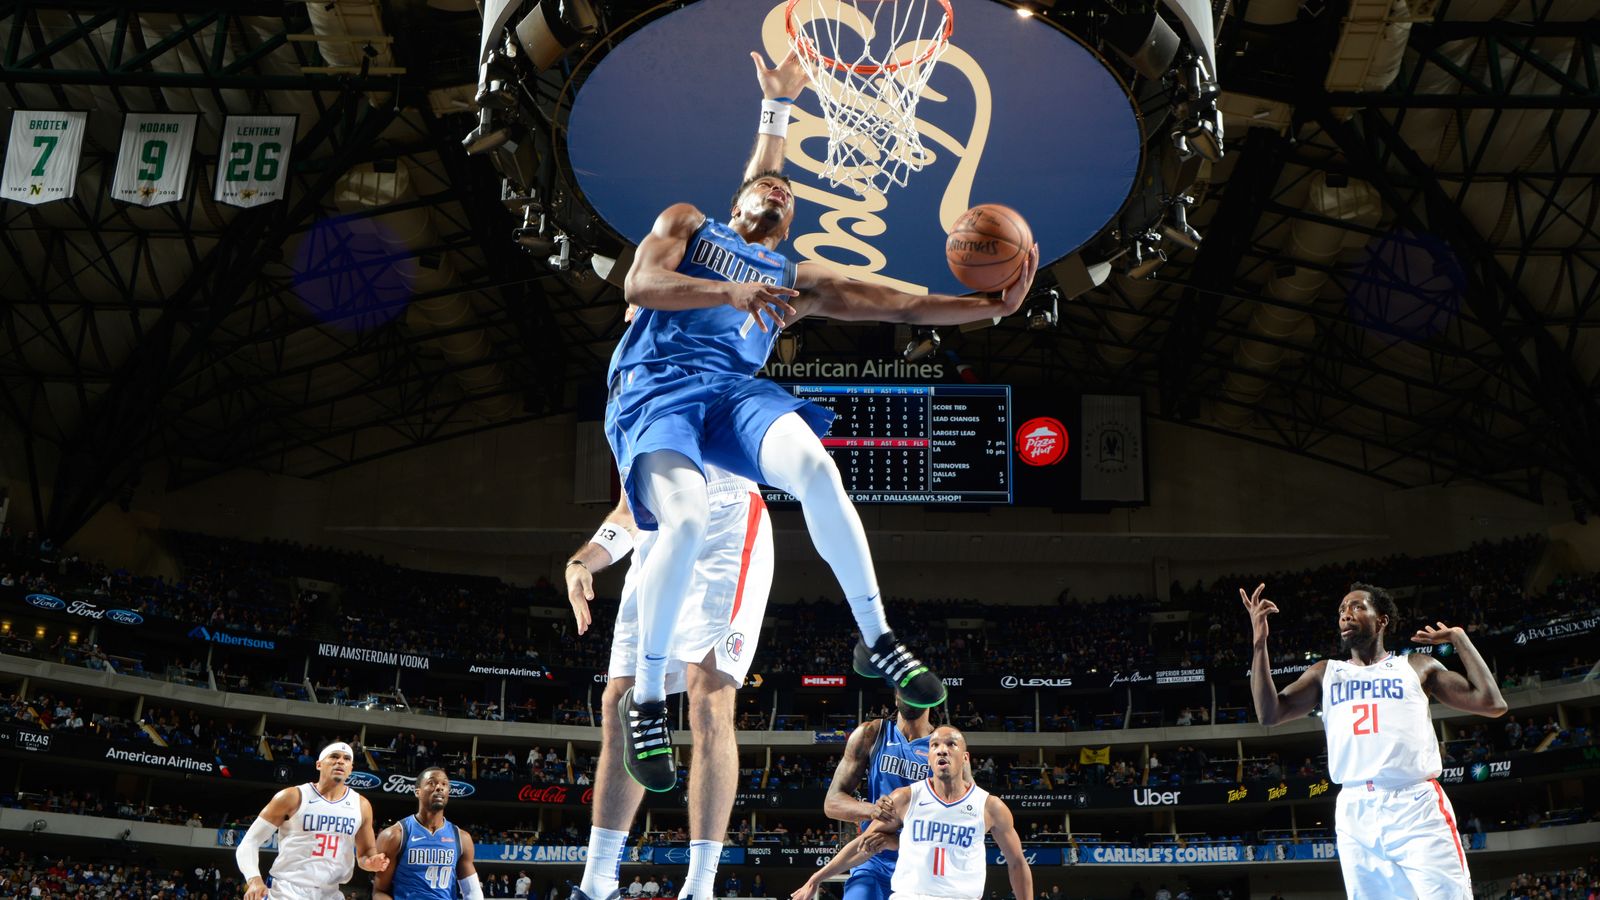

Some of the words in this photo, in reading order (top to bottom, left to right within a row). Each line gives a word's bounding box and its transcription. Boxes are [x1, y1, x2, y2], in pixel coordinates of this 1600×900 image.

[29, 120, 68, 131] BROTEN
[140, 122, 179, 134] MODANO
[236, 126, 280, 137] LEHTINEN
[30, 136, 58, 176] 7
[138, 140, 168, 181] 9
[226, 142, 282, 182] 26
[755, 360, 860, 378] American
[860, 358, 944, 378] Airlines
[1026, 437, 1056, 451] Pizza
[1031, 446, 1054, 458] Hut
[598, 528, 616, 540] 13
[66, 600, 106, 620] Ford
[211, 632, 275, 650] Albertsons
[318, 643, 339, 658] NEW
[340, 646, 398, 665] AMSTERDAM
[399, 654, 429, 670] VODKA
[469, 665, 508, 675] American
[509, 667, 541, 678] Airlines
[593, 673, 608, 683] cit
[1180, 668, 1205, 676] SKINCARE
[942, 678, 964, 686] AT&T
[1020, 678, 1072, 687] LEXUS
[1330, 678, 1404, 706] CLIPPERS
[1352, 703, 1379, 735] 21
[19, 731, 49, 746] TEXAS
[105, 747, 166, 766] American
[166, 755, 213, 772] Airlines
[880, 754, 929, 779] DALLAS
[1489, 760, 1512, 772] TXU
[1443, 767, 1464, 778] TXU
[382, 774, 417, 793] For
[1228, 785, 1248, 803] Takis
[1268, 784, 1287, 800] Takis
[1309, 780, 1328, 798] Takis
[1133, 789, 1181, 806] Uber
[303, 814, 356, 836] CLIPPERS
[913, 820, 976, 848] CLIPPERS
[311, 834, 339, 858] 34
[500, 845, 532, 860] JJ'S
[534, 847, 588, 861] AMIGO
[1094, 847, 1172, 863] CARLISLE'S
[1175, 846, 1238, 862] CORNER
[408, 848, 454, 866] DALLAS
[816, 857, 829, 866] 68
[933, 847, 945, 876] 11
[425, 866, 452, 889] 40
